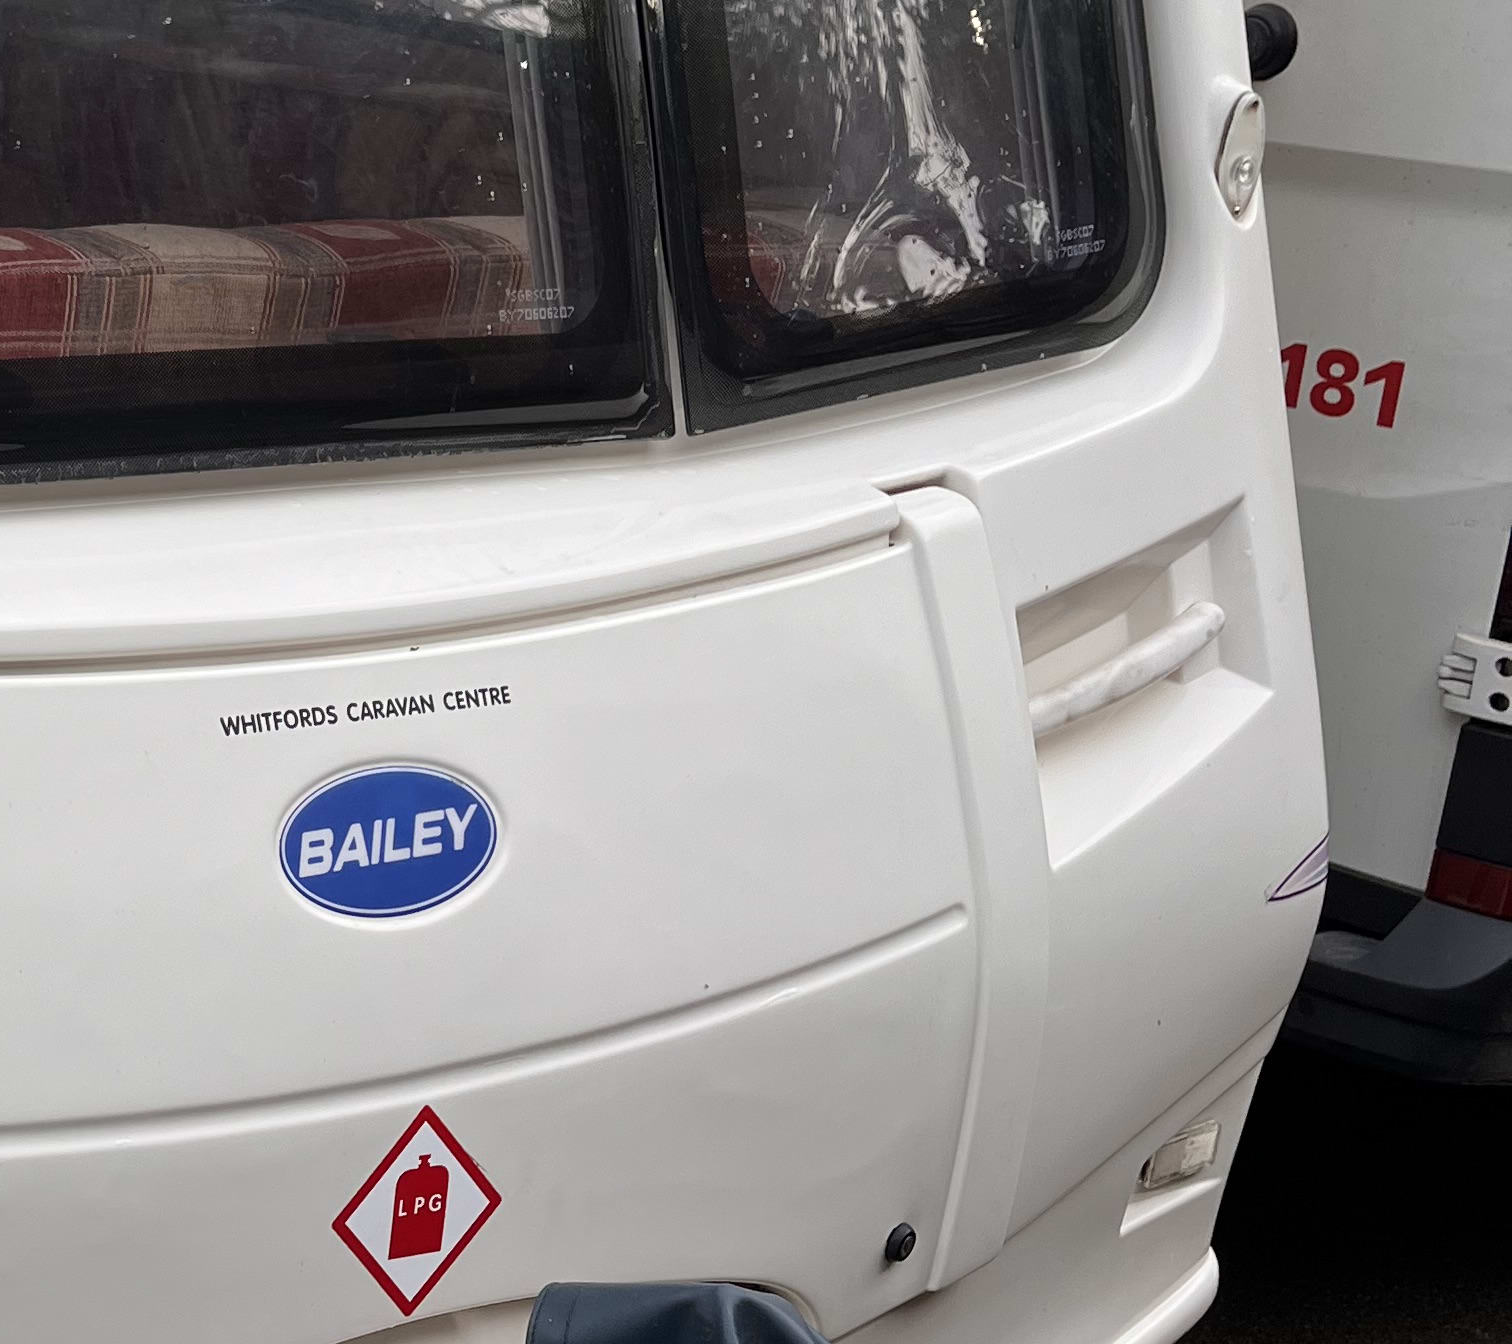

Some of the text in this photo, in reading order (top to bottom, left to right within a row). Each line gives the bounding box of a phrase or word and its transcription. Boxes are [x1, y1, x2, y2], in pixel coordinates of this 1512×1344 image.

[1280, 343, 1405, 429] 181
[219, 685, 512, 737] WHITFORDS CARAVAN CENTRE
[298, 803, 478, 879] BAILEY
